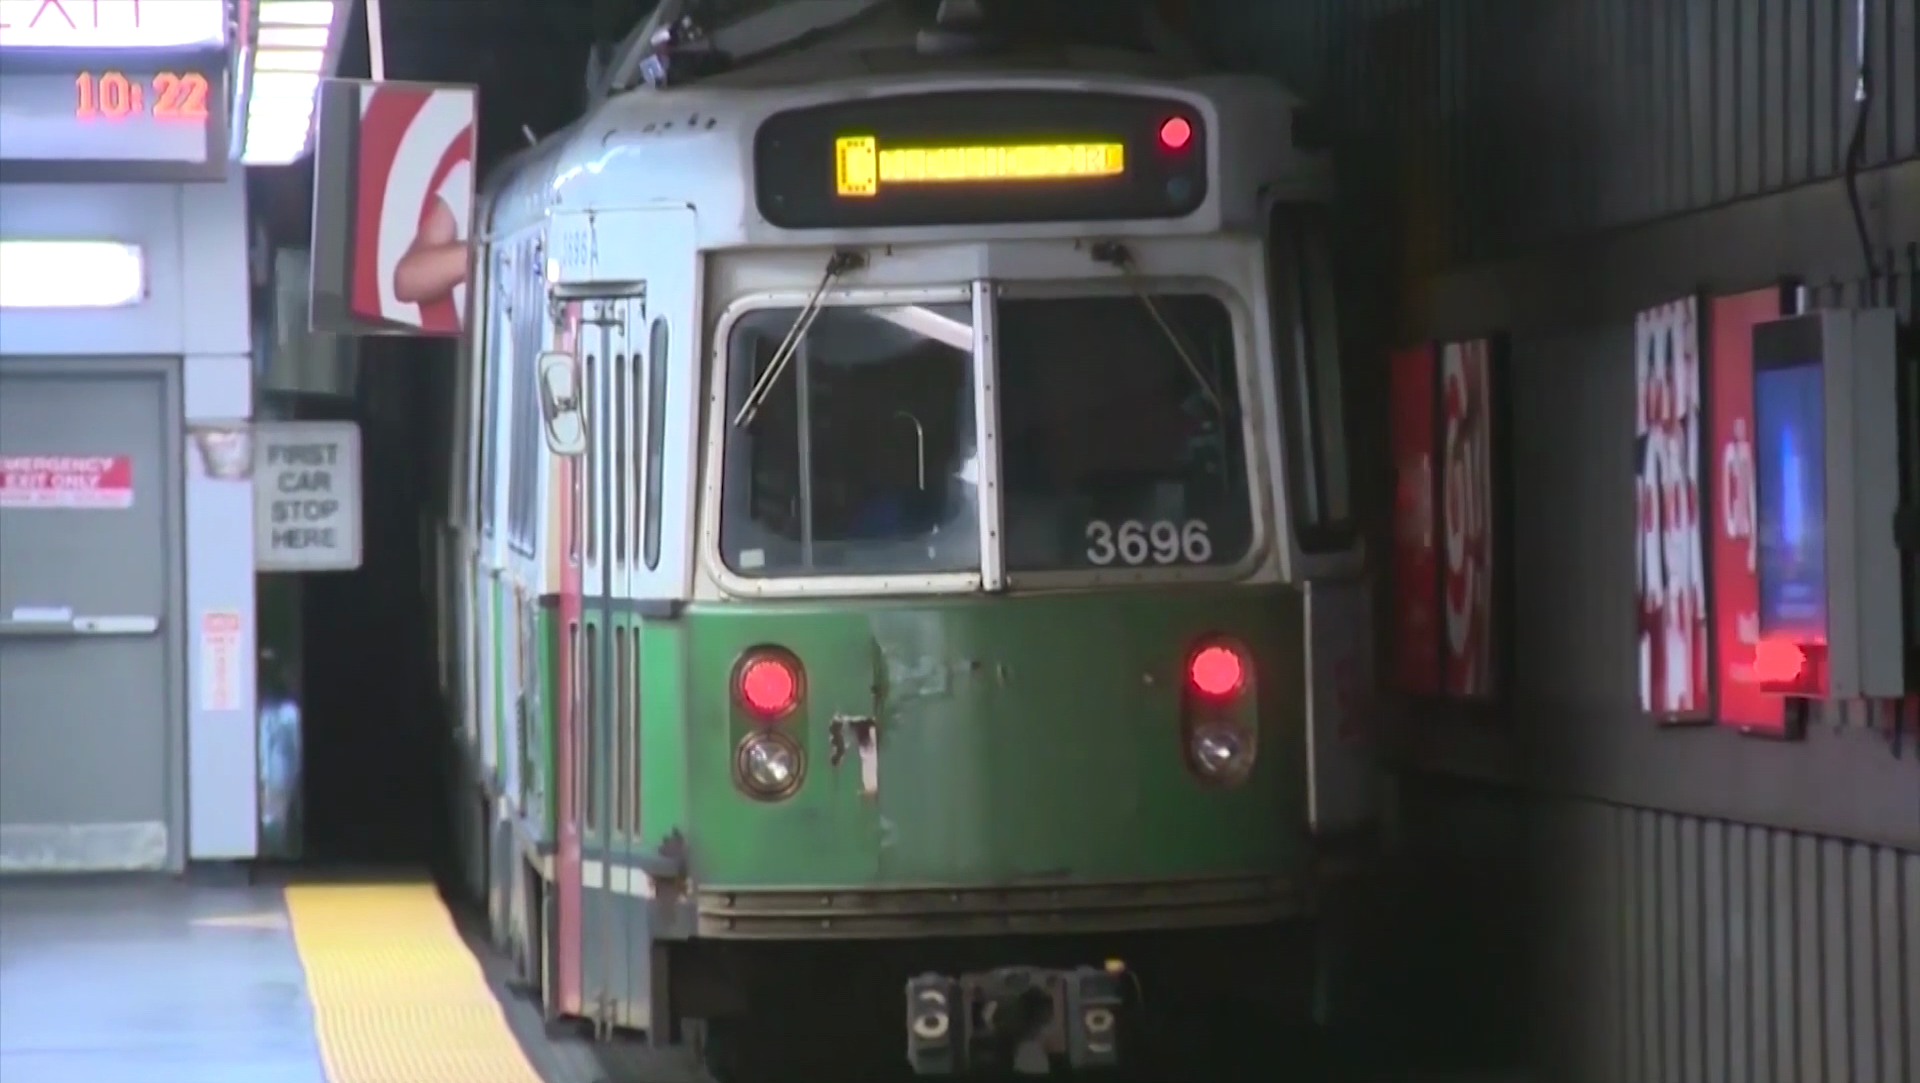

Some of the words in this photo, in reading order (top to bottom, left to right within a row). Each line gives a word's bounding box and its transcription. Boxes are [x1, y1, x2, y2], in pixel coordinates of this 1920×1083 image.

[76, 71, 208, 118] 10:22
[0, 457, 113, 472] MERGENCY
[267, 444, 338, 466] FIRST
[6, 473, 47, 489] EXIT
[51, 473, 101, 489] ONLY
[278, 471, 332, 493] CAR
[271, 501, 339, 522] STOP
[271, 530, 336, 549] HERE
[1086, 519, 1212, 565] 3696
